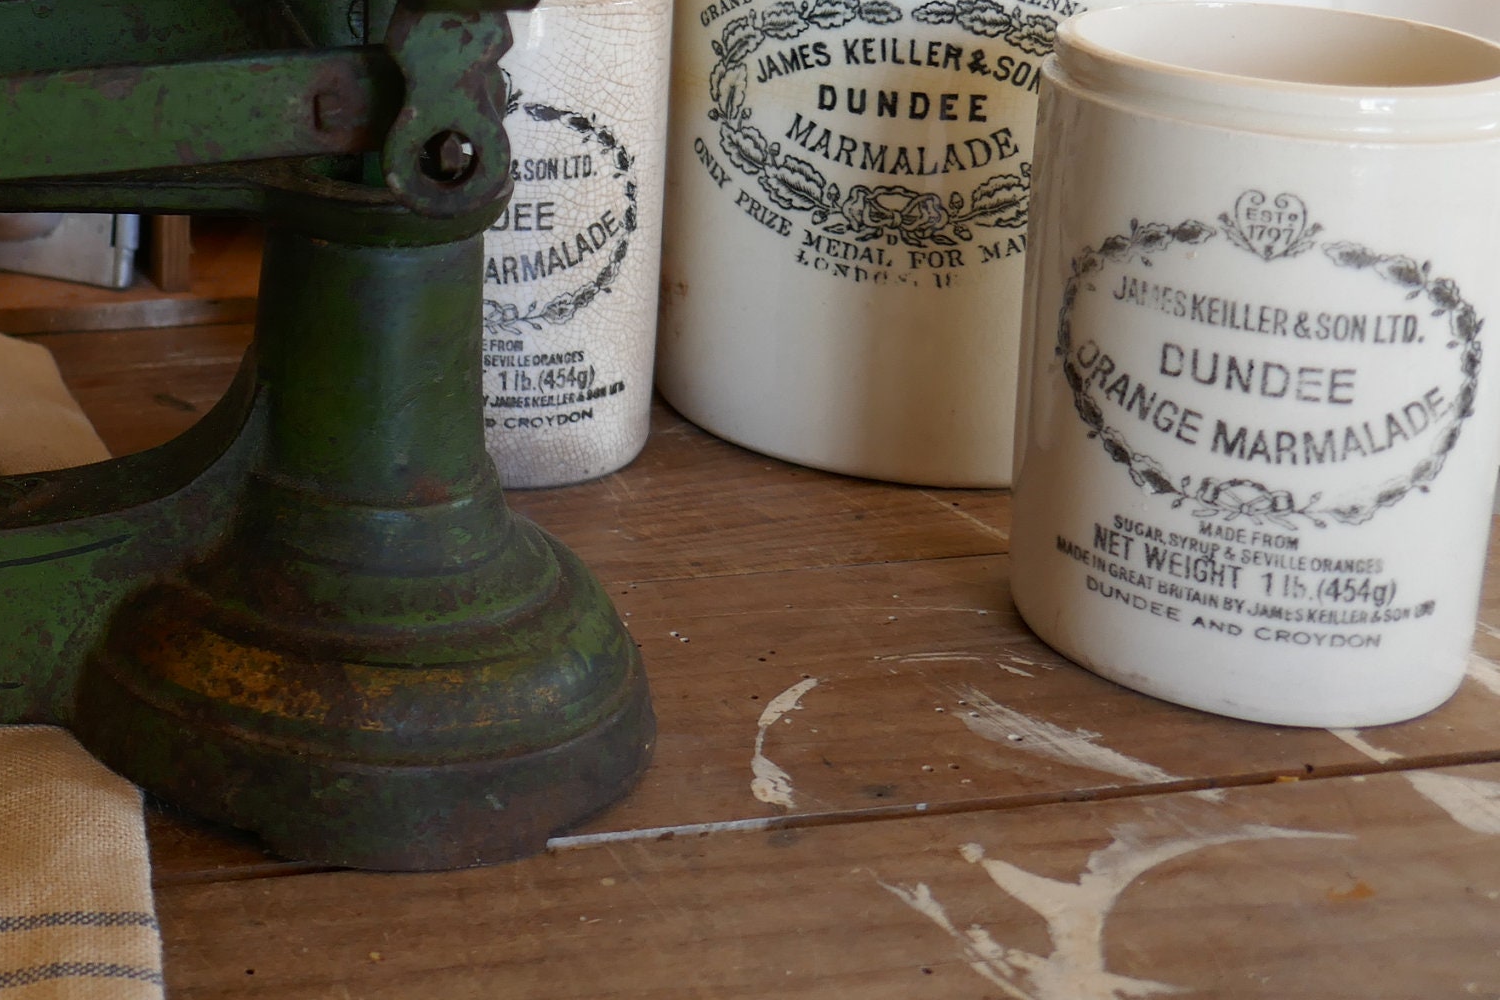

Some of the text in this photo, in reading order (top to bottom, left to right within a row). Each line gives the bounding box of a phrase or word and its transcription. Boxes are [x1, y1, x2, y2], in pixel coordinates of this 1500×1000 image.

[757, 42, 831, 84] JAMES
[843, 37, 963, 71] KEILLER
[967, 49, 991, 76] &
[818, 84, 988, 122] DUNDEE
[785, 112, 1020, 176] MARMALADE
[510, 159, 521, 181] &
[524, 157, 558, 181] SON
[693, 137, 732, 189] ONLY
[734, 188, 793, 237] PRIZE
[802, 229, 893, 266] MEDAL
[908, 249, 964, 269] FOR
[484, 209, 620, 285] ARMALADE
[1248, 224, 1295, 245] 1797
[1191, 293, 1288, 336] KEILLER
[1293, 311, 1312, 339] &
[1316, 313, 1367, 342] SON
[490, 339, 524, 352] FROM
[1160, 342, 1357, 405] DUNDEE
[504, 407, 594, 429] CROYDON
[1077, 340, 1447, 466] ORANGE MARMALADE
[1093, 522, 1134, 560] NET
[1144, 543, 1242, 590] WEIGHT
[1261, 572, 1274, 597] 1
[1169, 533, 1220, 558] SYRUP
[1223, 547, 1236, 562] &
[1241, 549, 1306, 572] SEVILLE
[1311, 557, 1384, 574] ORANGES
[1199, 520, 1299, 550] MADE FROM
[1056, 535, 1090, 566] MADE
[1092, 554, 1107, 573] IN
[1108, 563, 1154, 591] GREAT
[1158, 580, 1219, 609] BRITAIN
[1223, 597, 1246, 615] BY
[1247, 602, 1304, 622] JAMES
[1306, 608, 1367, 625] KEILLER
[1370, 608, 1382, 624] &
[1384, 608, 1410, 622] SON
[1086, 574, 1383, 648] DUNDEE AND CROYDON
